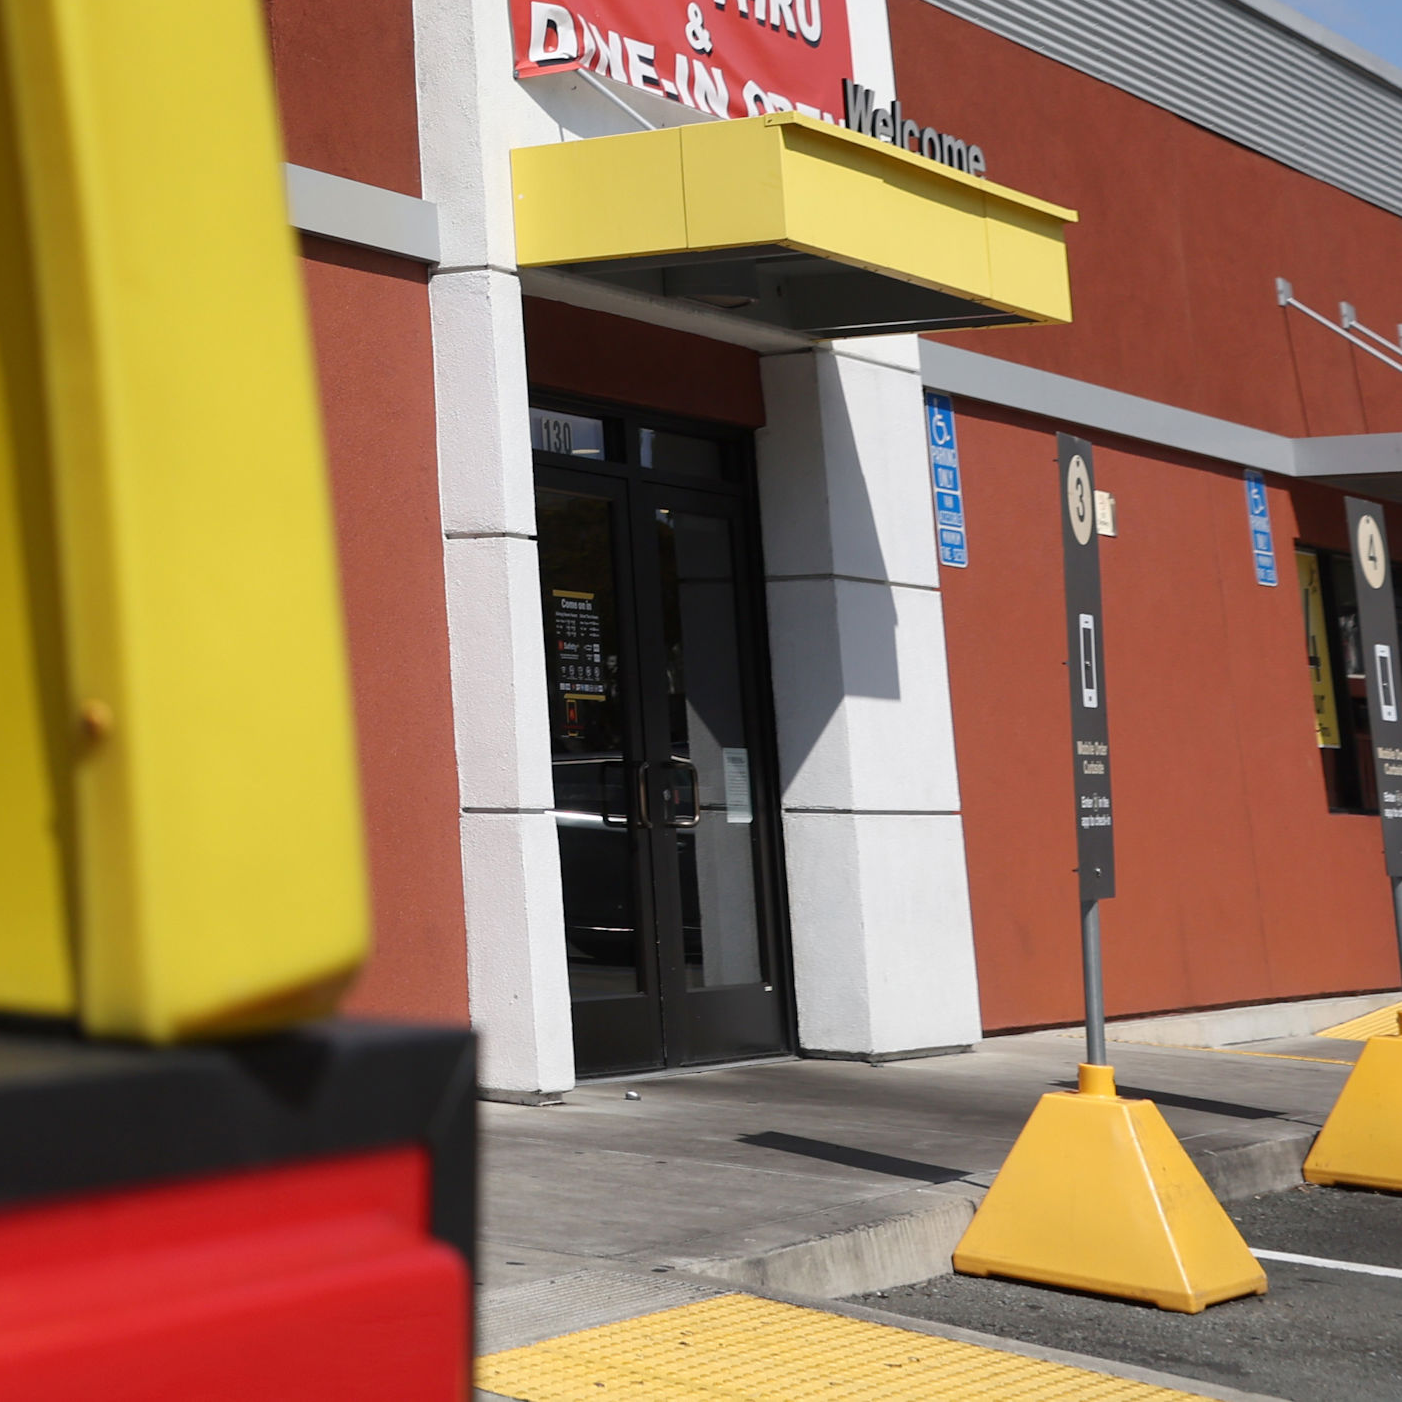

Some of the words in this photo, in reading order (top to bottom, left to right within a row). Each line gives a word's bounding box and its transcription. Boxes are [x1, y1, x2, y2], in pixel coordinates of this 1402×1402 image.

[683, 1, 712, 55] &
[842, 78, 986, 180] Welcome
[1075, 477, 1085, 522] 3
[1367, 533, 1378, 571] 4
